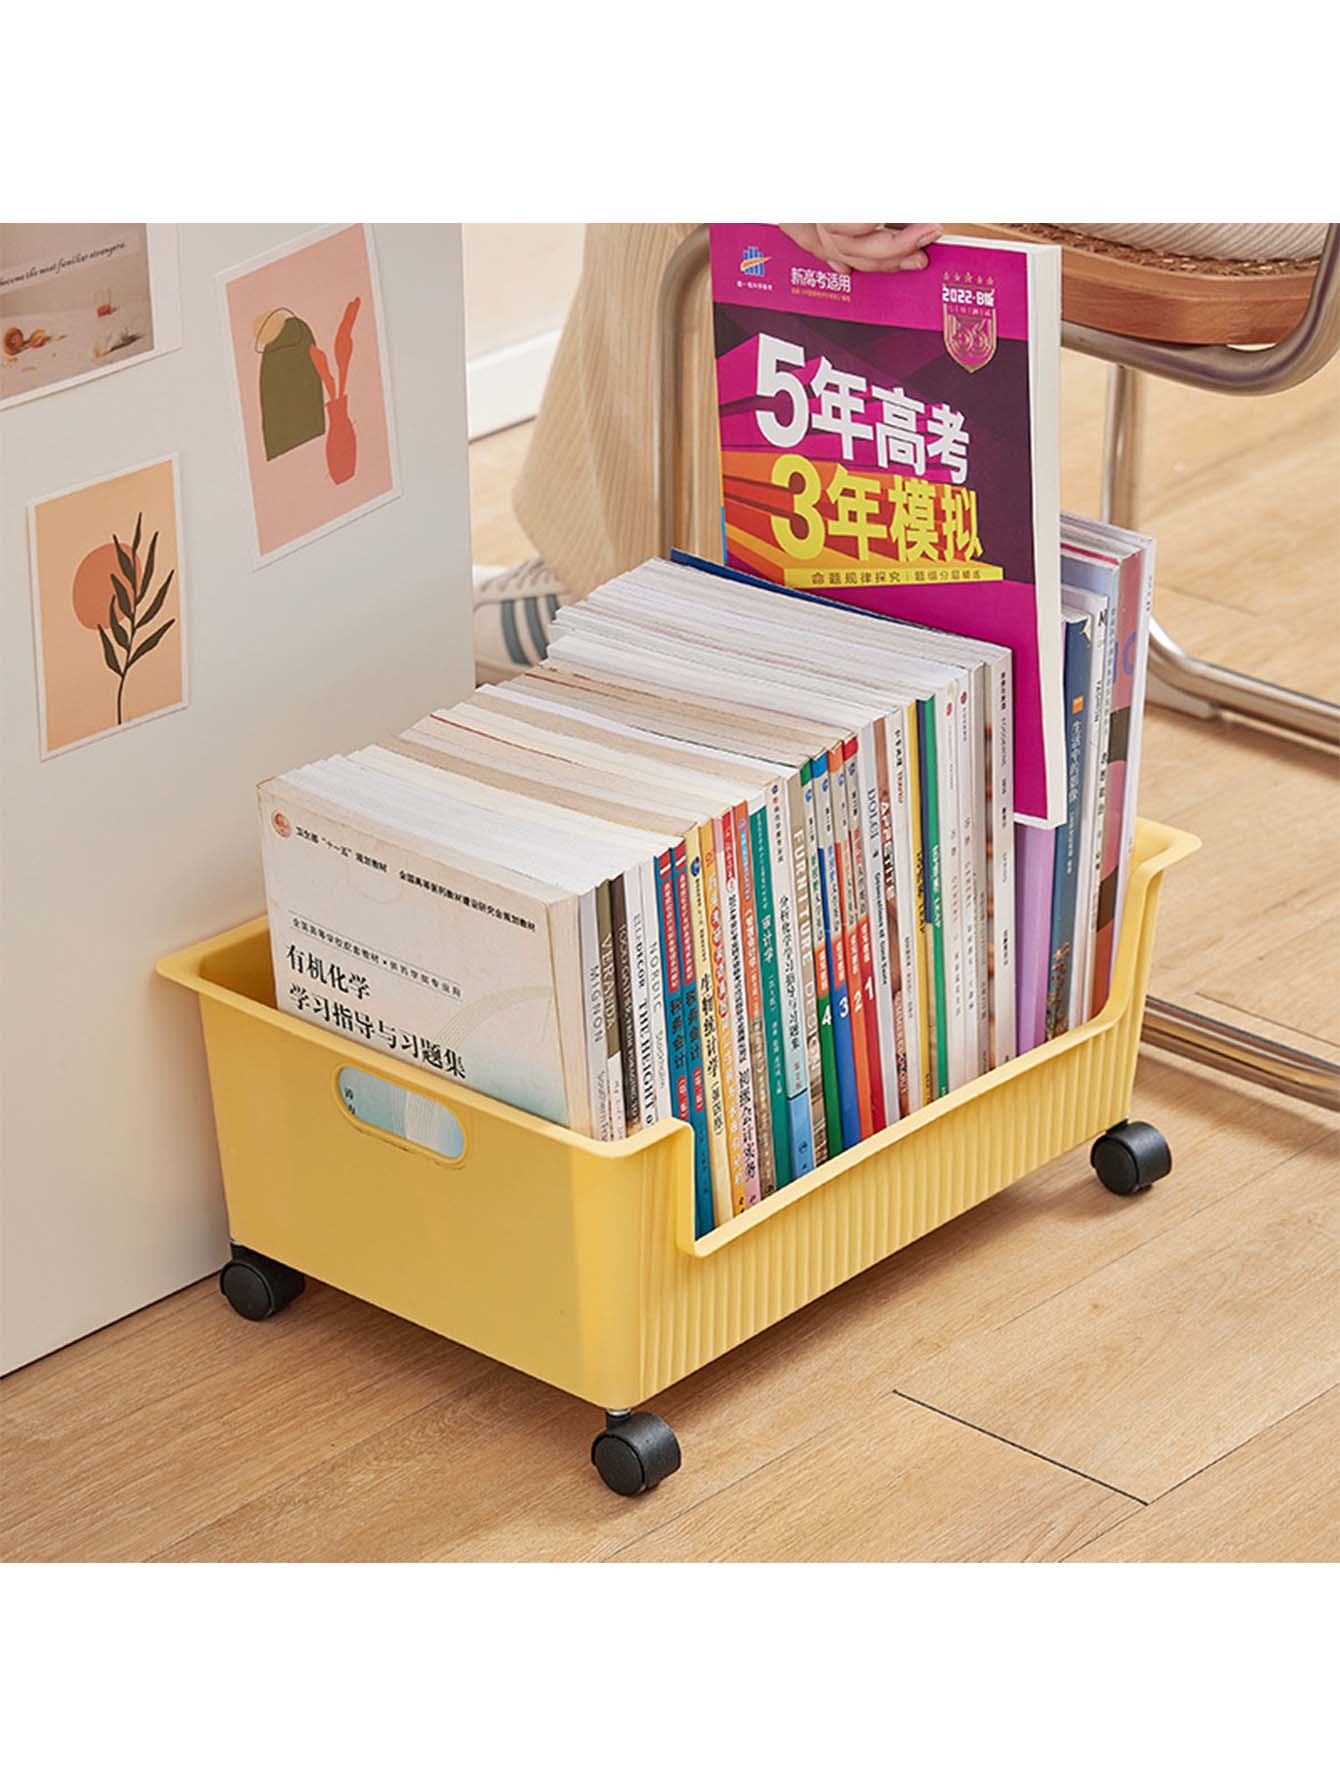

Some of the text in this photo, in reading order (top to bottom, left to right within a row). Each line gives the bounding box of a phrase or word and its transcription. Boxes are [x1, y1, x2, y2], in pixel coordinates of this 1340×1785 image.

[26, 266, 37, 279] the
[56, 253, 88, 274] familiar
[755, 333, 970, 484] 5年高考
[770, 453, 983, 562] 3年模拟
[811, 571, 901, 585] 命题规律探究
[867, 787, 879, 840] DOLCI
[880, 801, 896, 901] APPETITE
[793, 829, 813, 967] FURNITURE
[286, 944, 370, 1000] 有机化学
[601, 932, 616, 1030] VERANDA
[635, 942, 646, 989] DECOR
[649, 941, 663, 1013] NORDIC
[864, 976, 874, 1000] 1
[590, 964, 605, 1043] MIGNON
[821, 1005, 832, 1026] 4
[838, 997, 850, 1019] 3
[853, 990, 864, 1013] 2
[289, 982, 466, 1079] 学习指导与习题集
